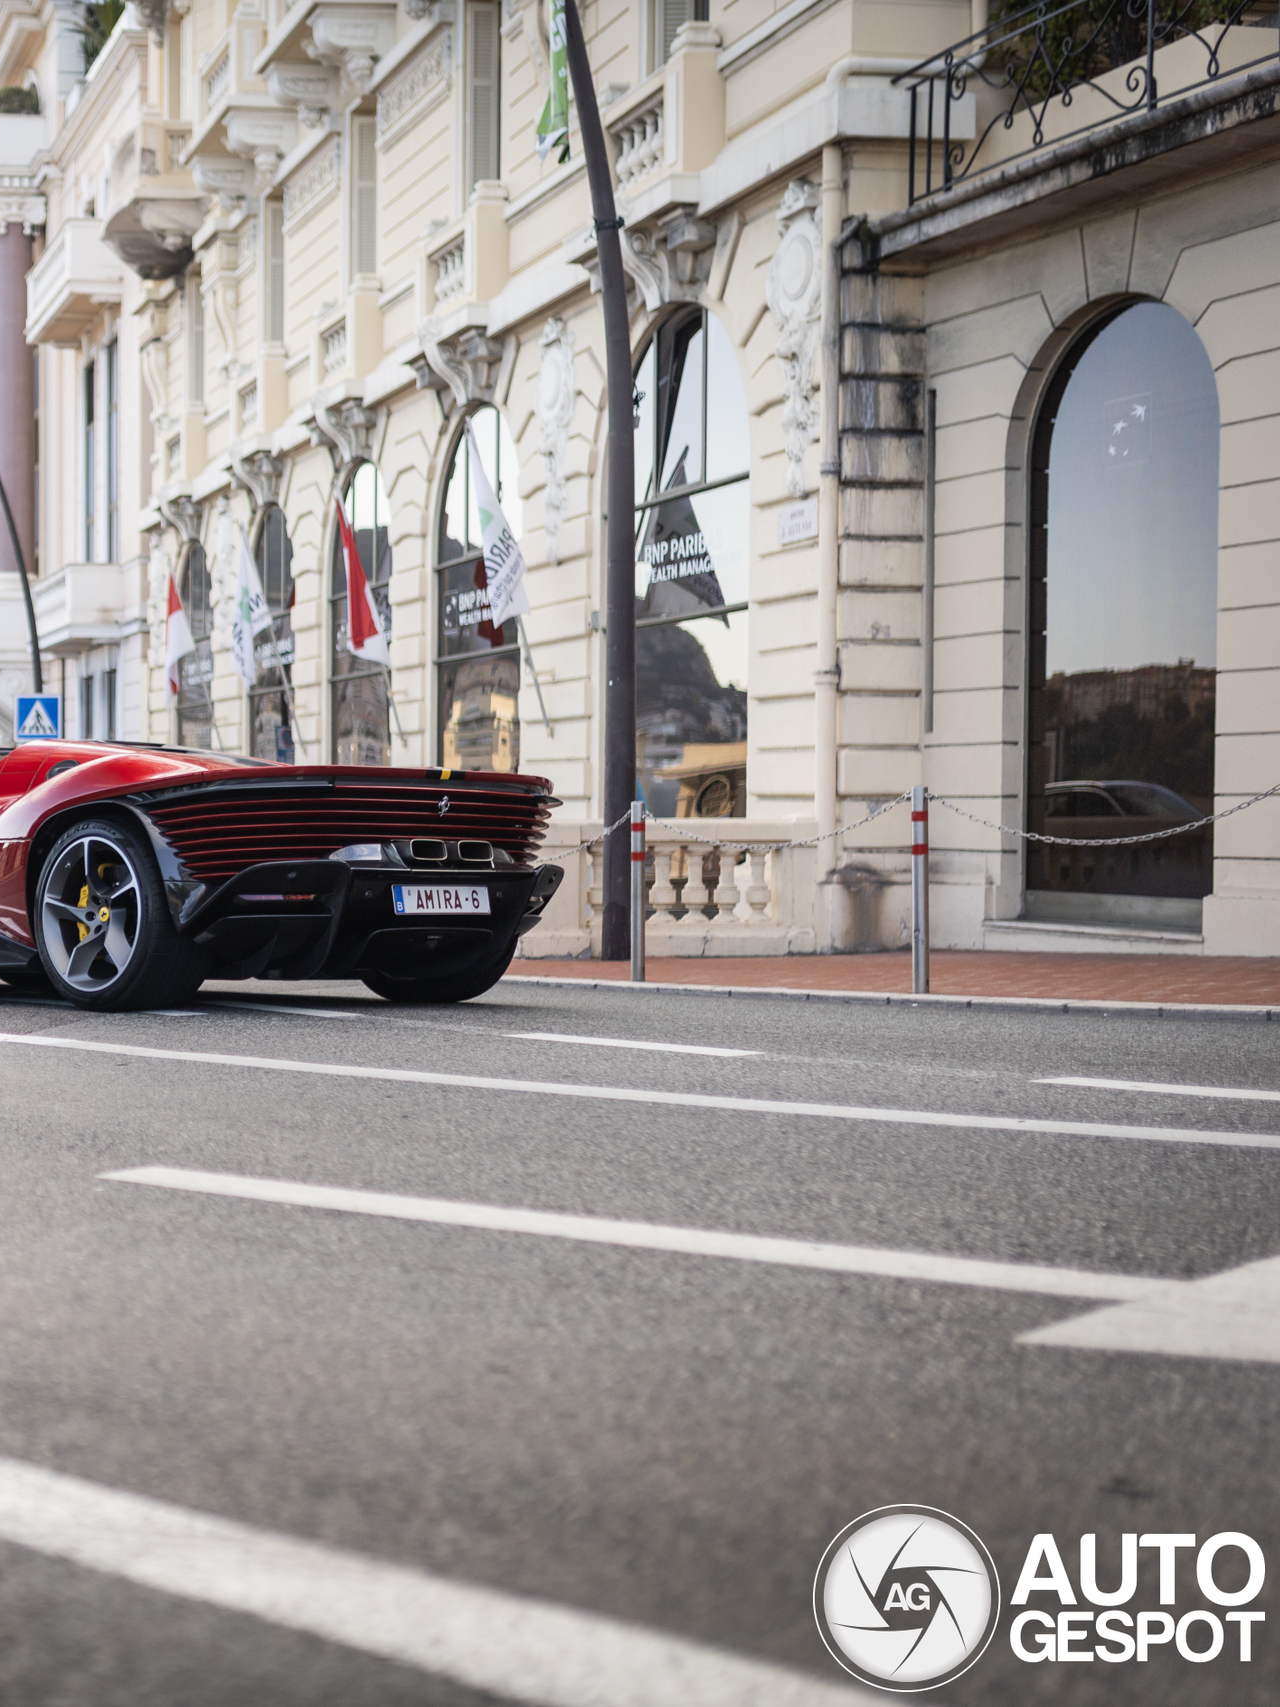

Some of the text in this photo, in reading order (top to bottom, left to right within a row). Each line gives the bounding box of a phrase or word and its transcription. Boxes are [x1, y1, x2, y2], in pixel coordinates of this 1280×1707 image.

[644, 526, 723, 565] BNP PARIB
[458, 590, 476, 612] BNP
[458, 609, 482, 626] WEALTH
[93, 824, 117, 837] CORSA
[396, 901, 404, 912] B
